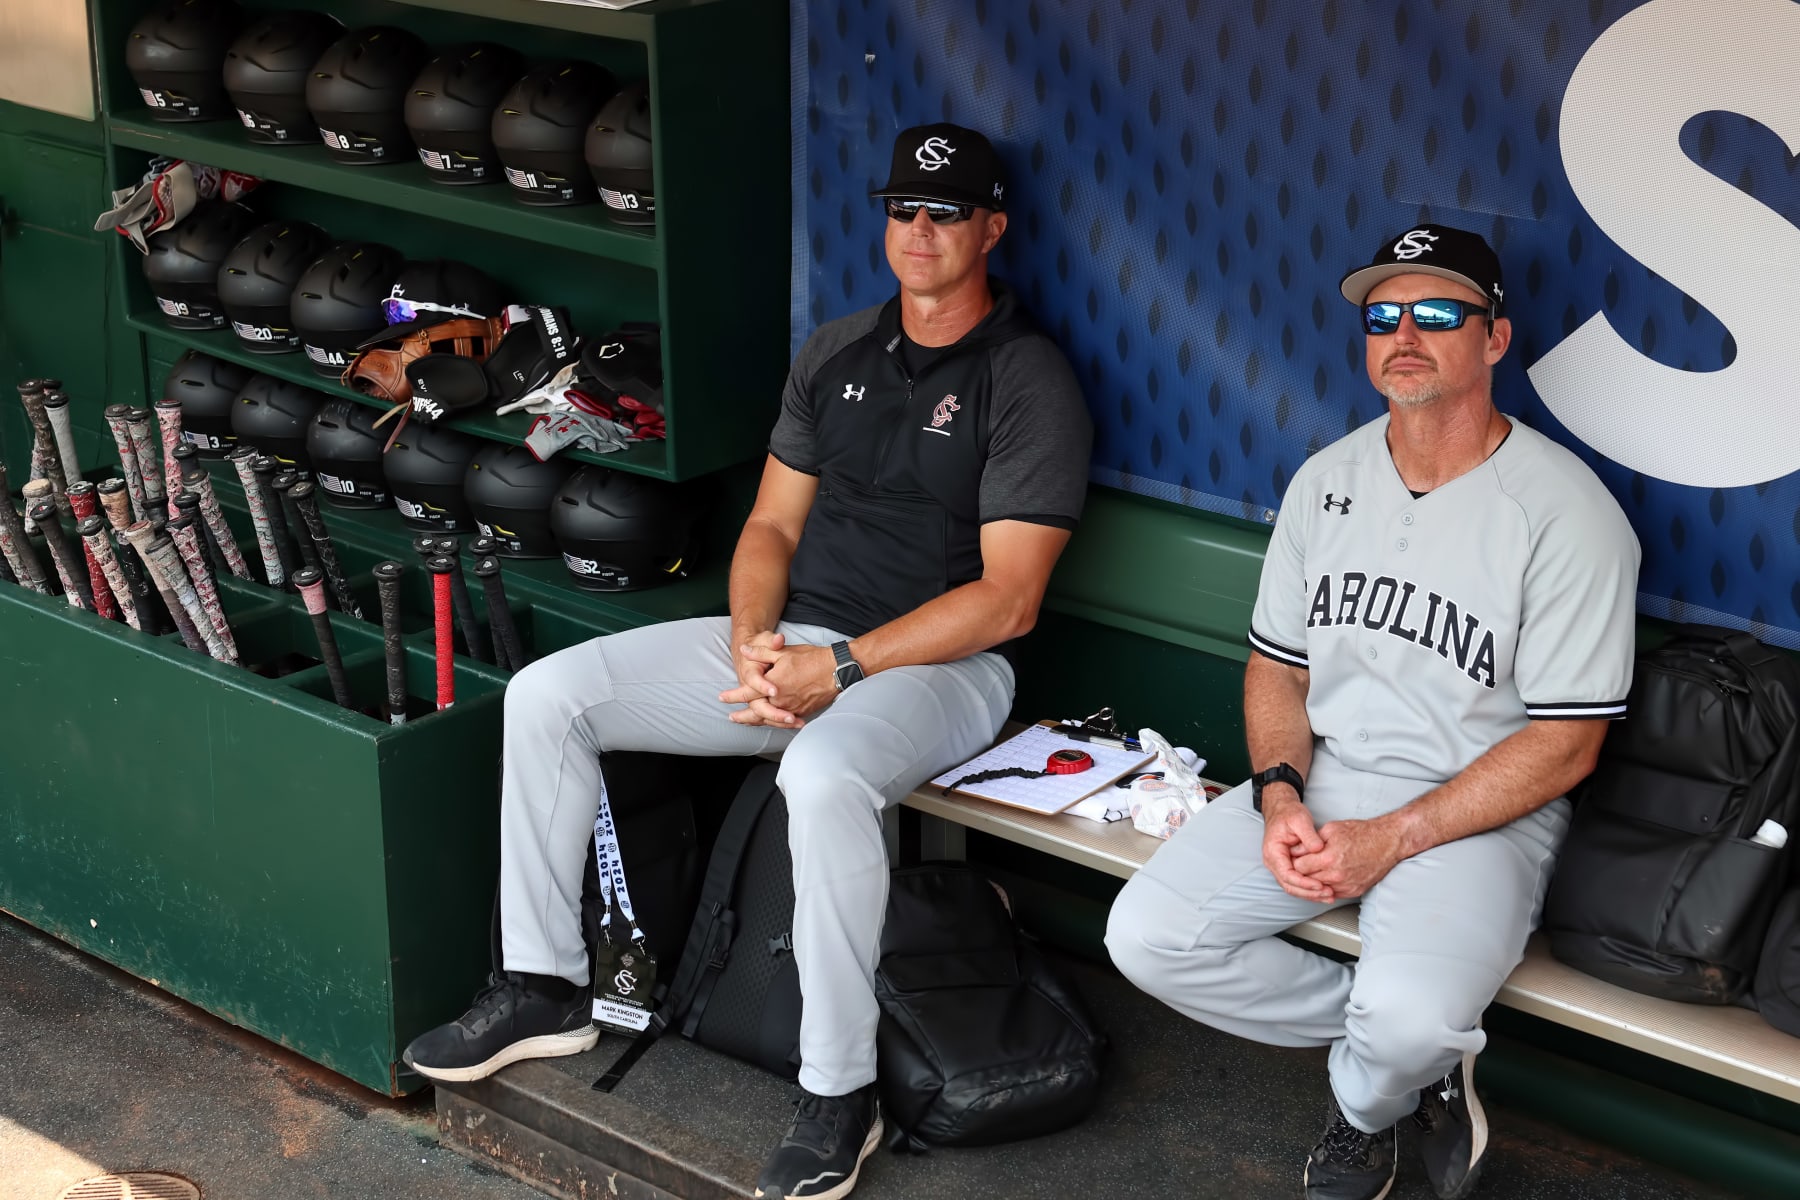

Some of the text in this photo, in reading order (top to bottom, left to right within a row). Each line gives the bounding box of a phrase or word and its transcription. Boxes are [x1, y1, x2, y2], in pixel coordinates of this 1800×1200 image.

[155, 92, 166, 107] 5
[246, 114, 256, 128] 6
[338, 134, 350, 150] 8
[441, 154, 451, 169] 7
[526, 174, 537, 188] 11
[623, 194, 639, 209] 13
[176, 302, 189, 316] 19
[255, 327, 273, 341] 20
[551, 336, 566, 359] 8:18
[328, 352, 345, 366] 44
[210, 436, 220, 449] 3
[340, 480, 355, 494] 10
[412, 504, 426, 518] 12
[583, 559, 601, 574] 52
[1304, 572, 1496, 689] AROLINA
[598, 844, 609, 878] 2024
[612, 860, 626, 893] 2024
[602, 1005, 643, 1019] MARK KINGSTON
